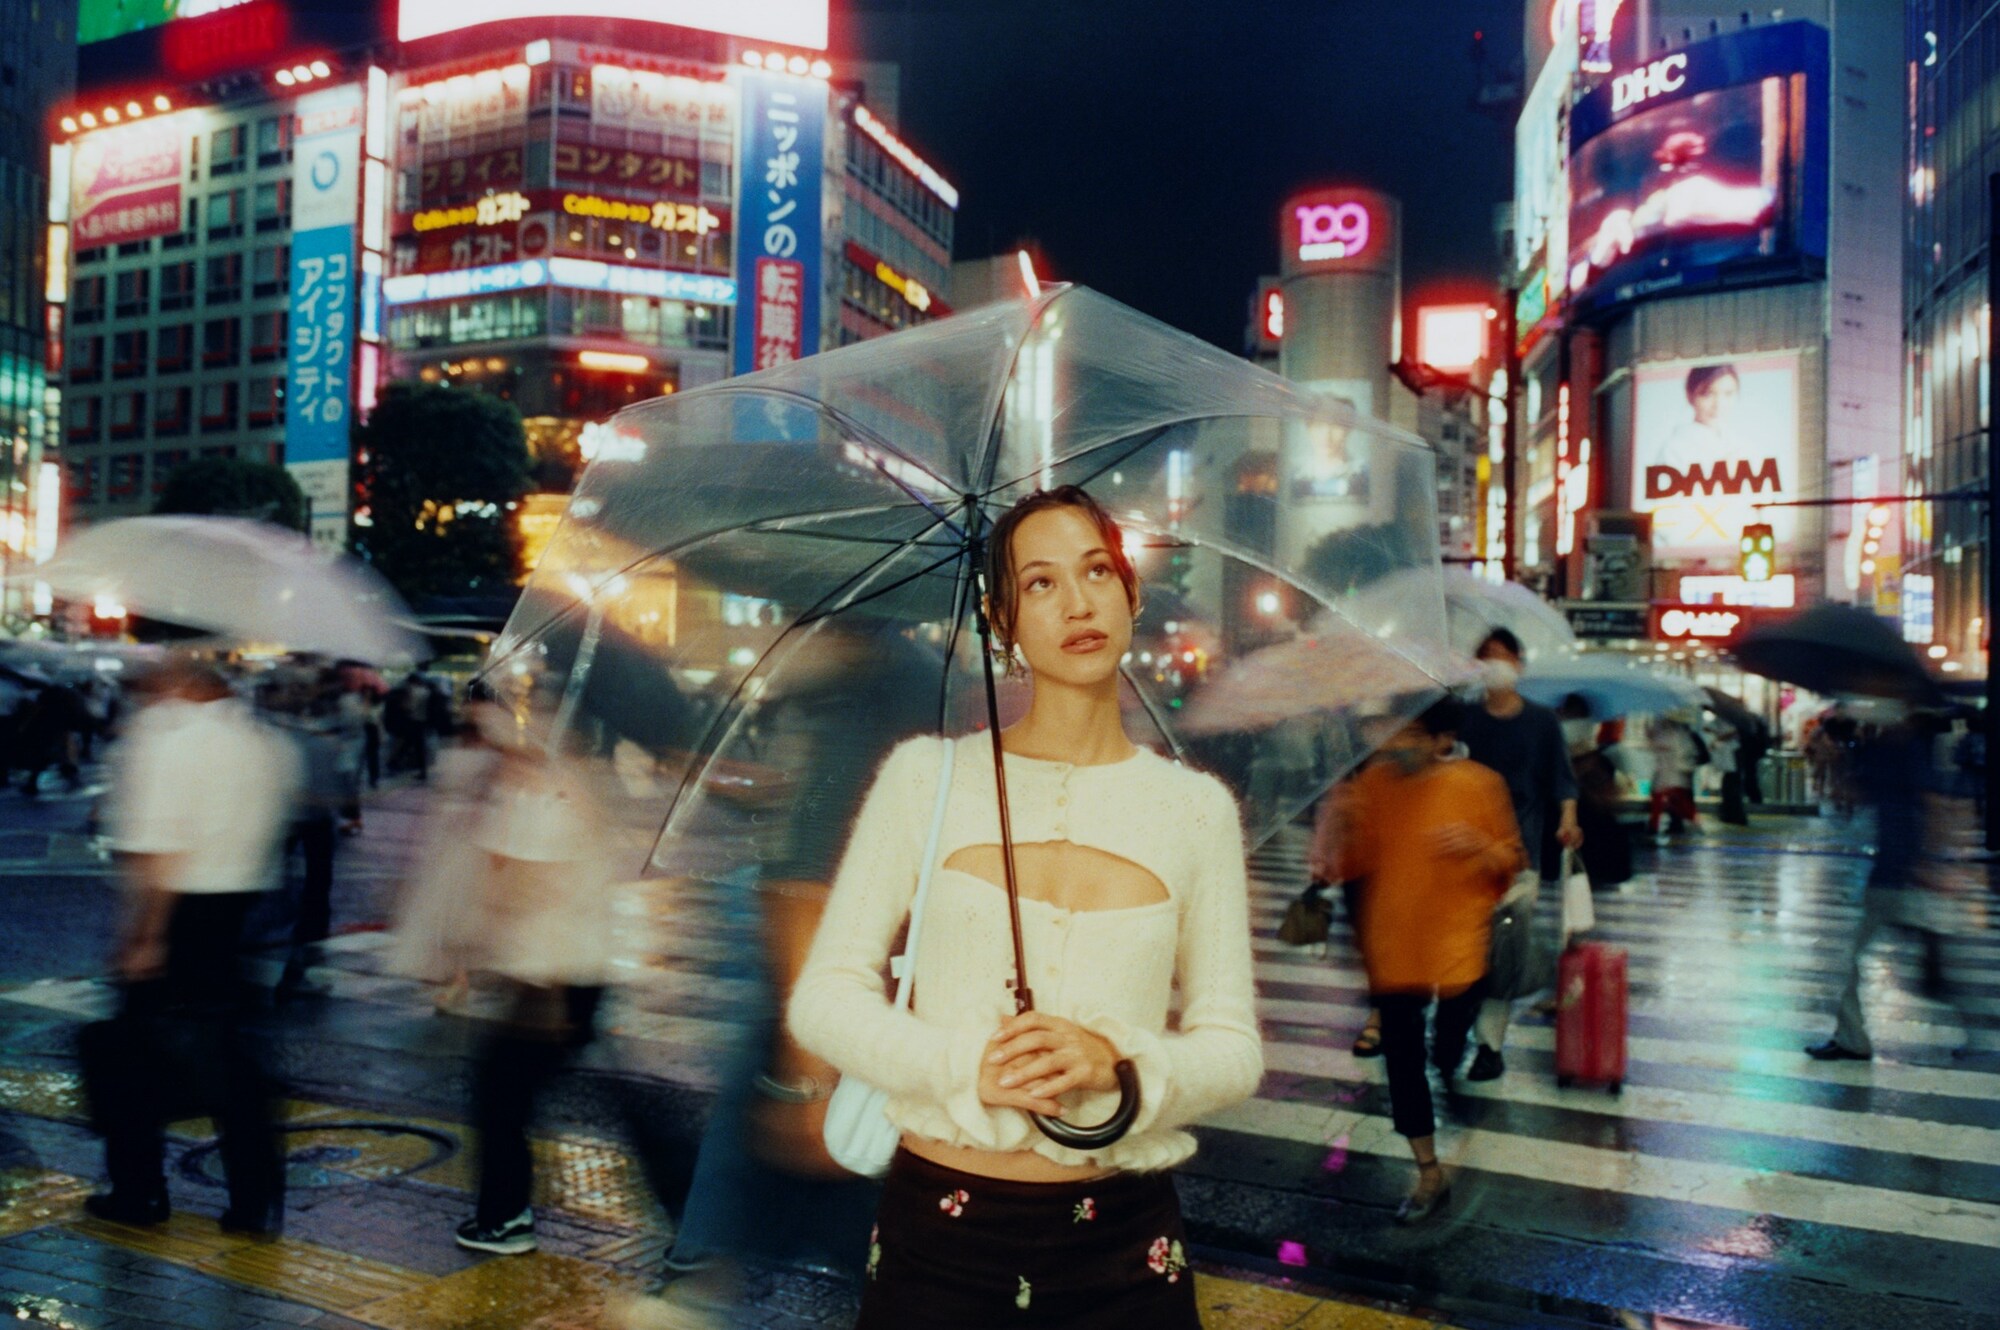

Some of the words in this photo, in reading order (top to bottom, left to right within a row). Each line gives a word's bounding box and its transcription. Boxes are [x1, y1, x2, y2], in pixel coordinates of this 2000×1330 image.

[1611, 52, 1687, 112] DHC
[556, 145, 696, 187] コンタクト
[651, 202, 720, 235] ガスト
[1296, 202, 1370, 258] 109
[296, 256, 325, 425] アイシティ
[1645, 458, 1782, 499] DMM
